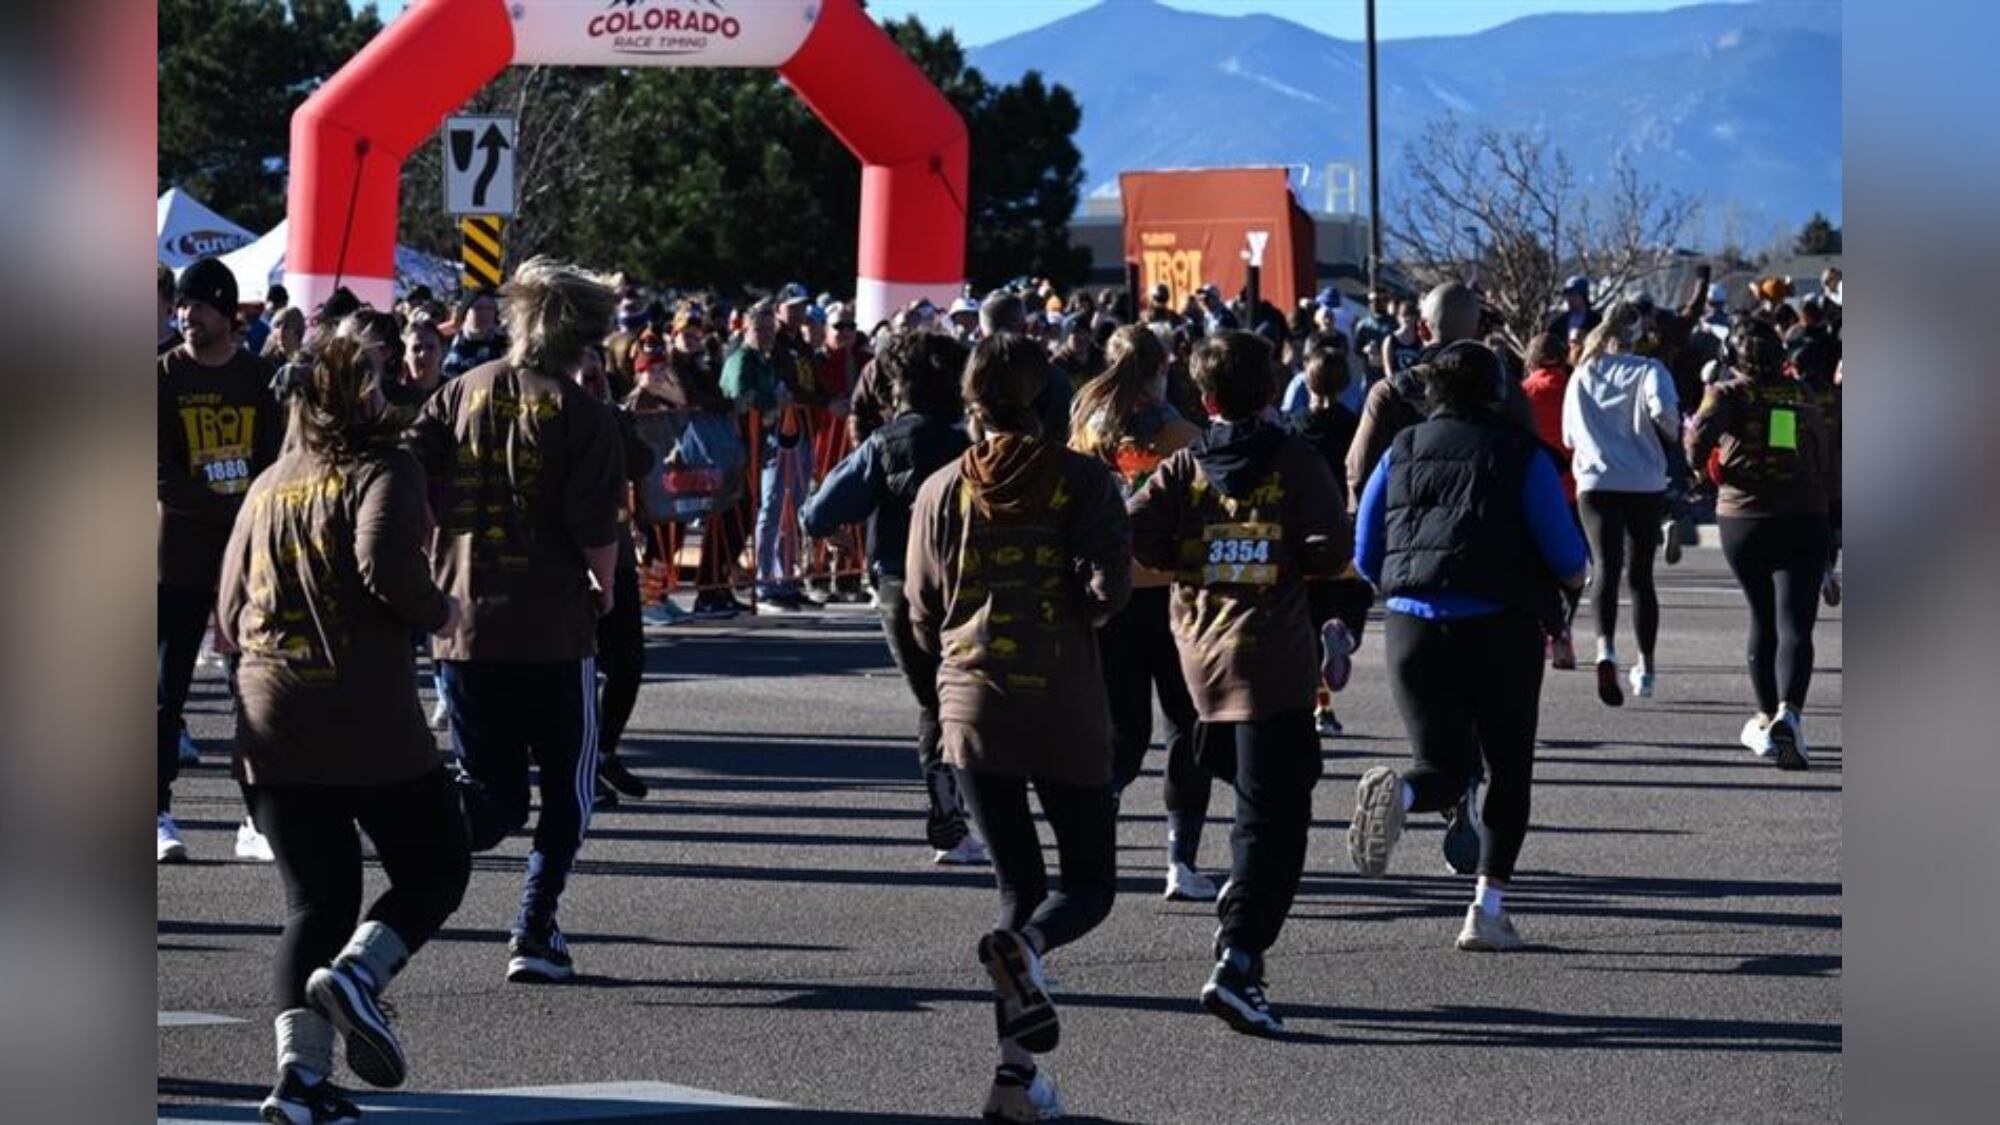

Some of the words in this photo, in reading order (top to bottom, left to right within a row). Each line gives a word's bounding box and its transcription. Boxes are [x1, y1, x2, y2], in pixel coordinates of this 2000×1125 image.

[588, 8, 740, 39] COLORADO
[614, 36, 652, 48] RACE
[660, 36, 708, 48] TIMING
[1209, 539, 1269, 563] 3354
